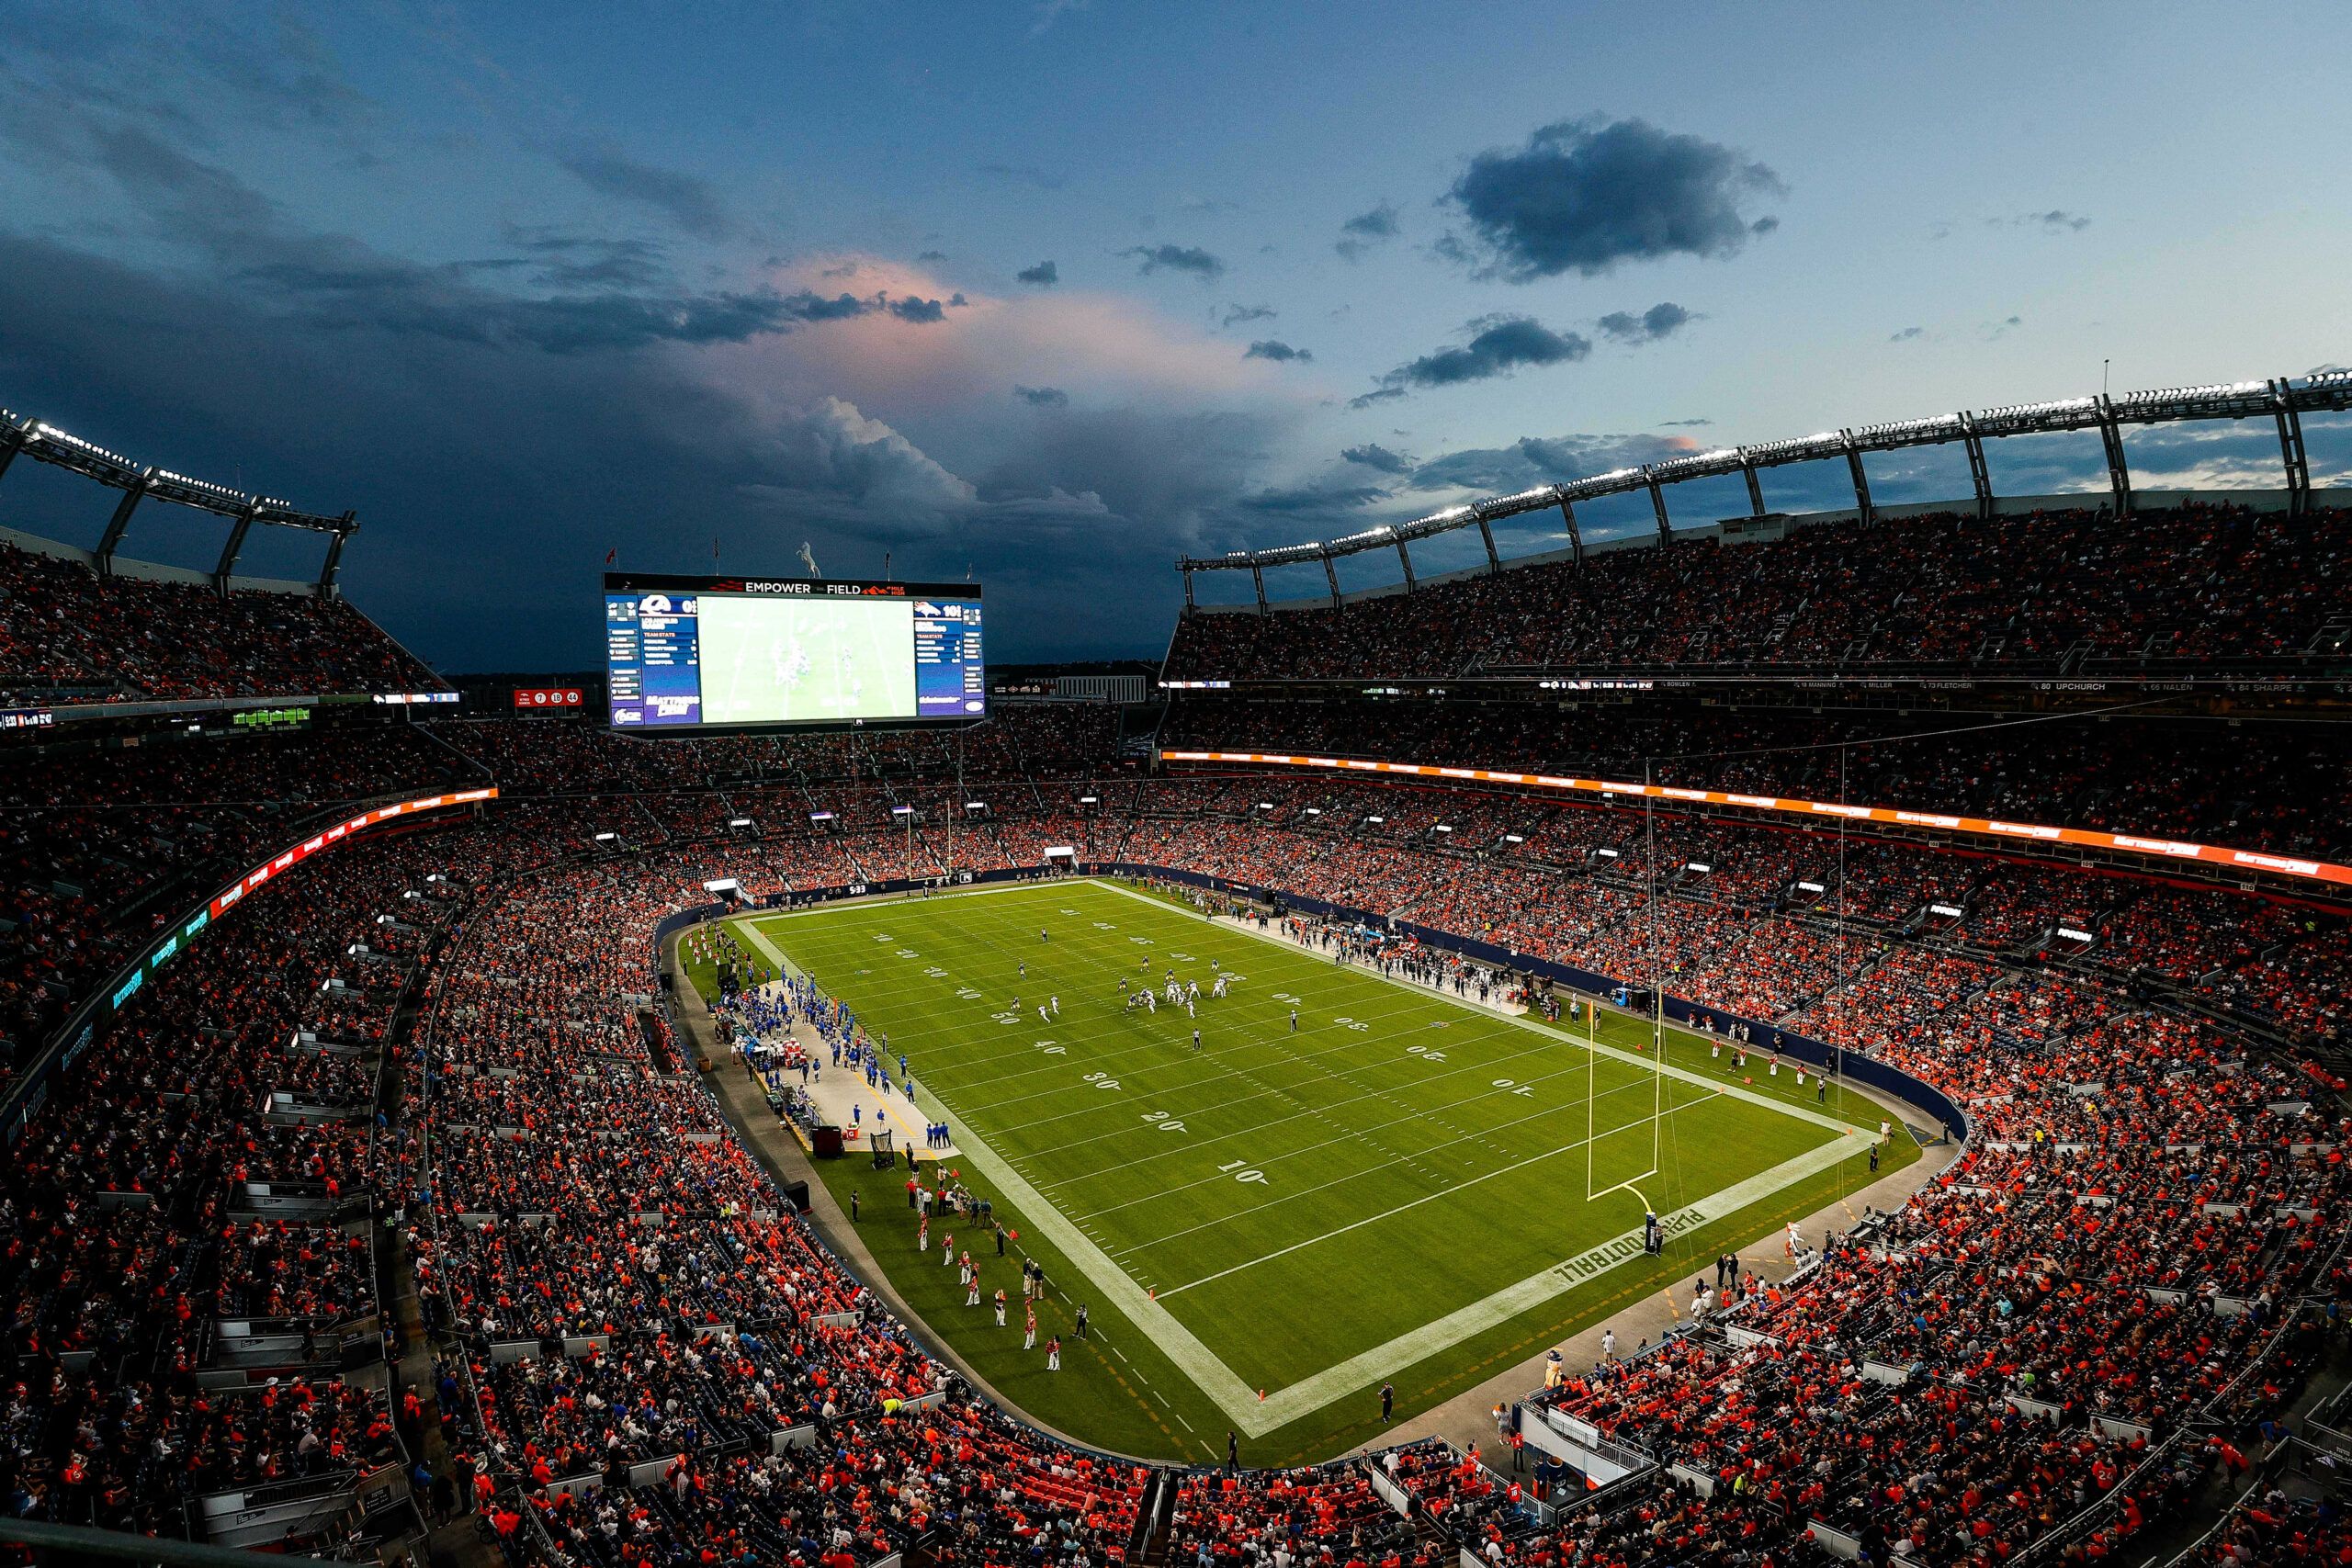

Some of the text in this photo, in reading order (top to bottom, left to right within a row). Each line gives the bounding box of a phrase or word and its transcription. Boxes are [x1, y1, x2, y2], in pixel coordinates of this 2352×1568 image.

[745, 581, 861, 595] EMPOWER FIELD
[849, 885, 866, 895] 5:33
[956, 987, 982, 999] 40
[1272, 993, 1301, 1006] 40
[990, 1011, 1021, 1024] 50
[1333, 1017, 1369, 1031] 30
[1034, 1041, 1066, 1055] 40
[1406, 1045, 1448, 1062] 20
[1082, 1071, 1119, 1090] 30
[1492, 1079, 1533, 1098] 10
[1140, 1111, 1185, 1132] 20
[1217, 1159, 1264, 1183] 10
[1553, 1230, 1646, 1283] FOOTBALL
[2098, 1470, 2114, 1481] 24
